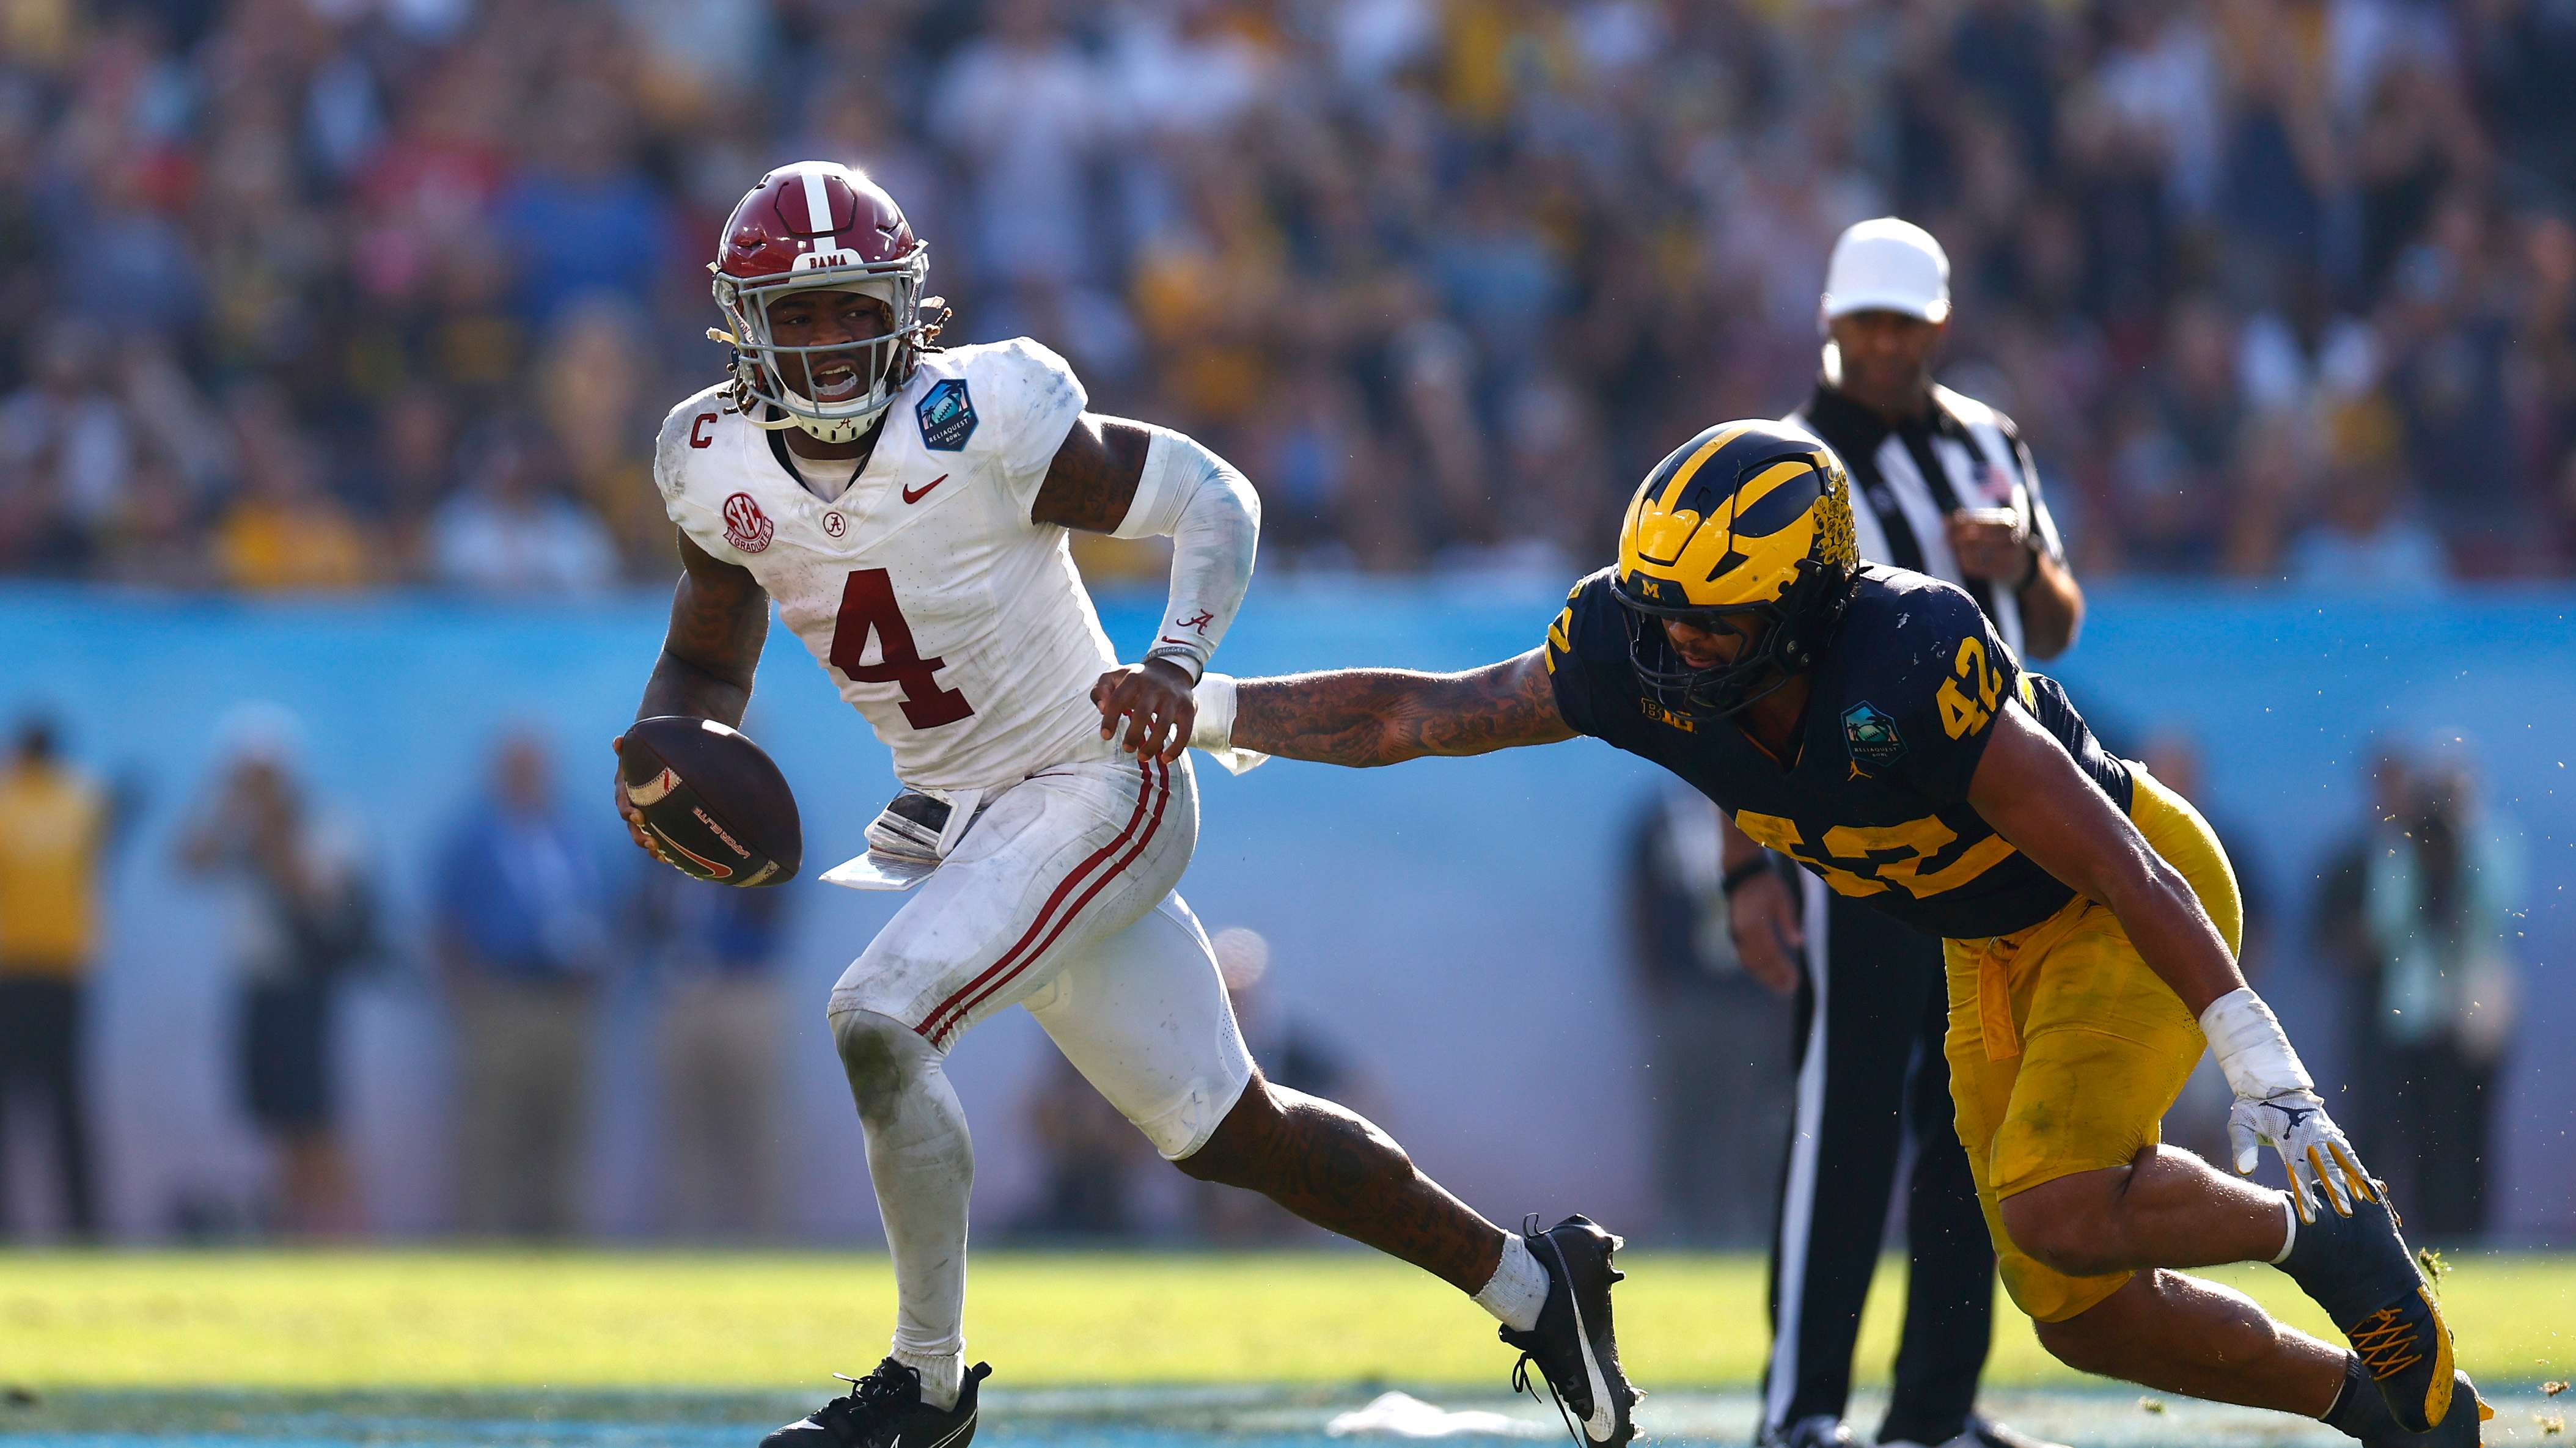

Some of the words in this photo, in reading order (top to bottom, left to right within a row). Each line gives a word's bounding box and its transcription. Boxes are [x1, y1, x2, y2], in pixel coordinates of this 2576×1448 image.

[809, 254, 847, 269] BAMA
[689, 413, 717, 448] C
[929, 419, 968, 443] RELIAQUEST
[945, 432, 961, 442] BOWL
[725, 495, 761, 538] SEC
[828, 516, 842, 532] A
[734, 530, 770, 552] GRADUATE
[1642, 579, 1659, 599] M
[1176, 608, 1214, 636] A
[829, 568, 975, 729] 4
[1936, 636, 2003, 741] 42
[693, 806, 722, 835] ELITE
[720, 830, 751, 859] VAPOR
